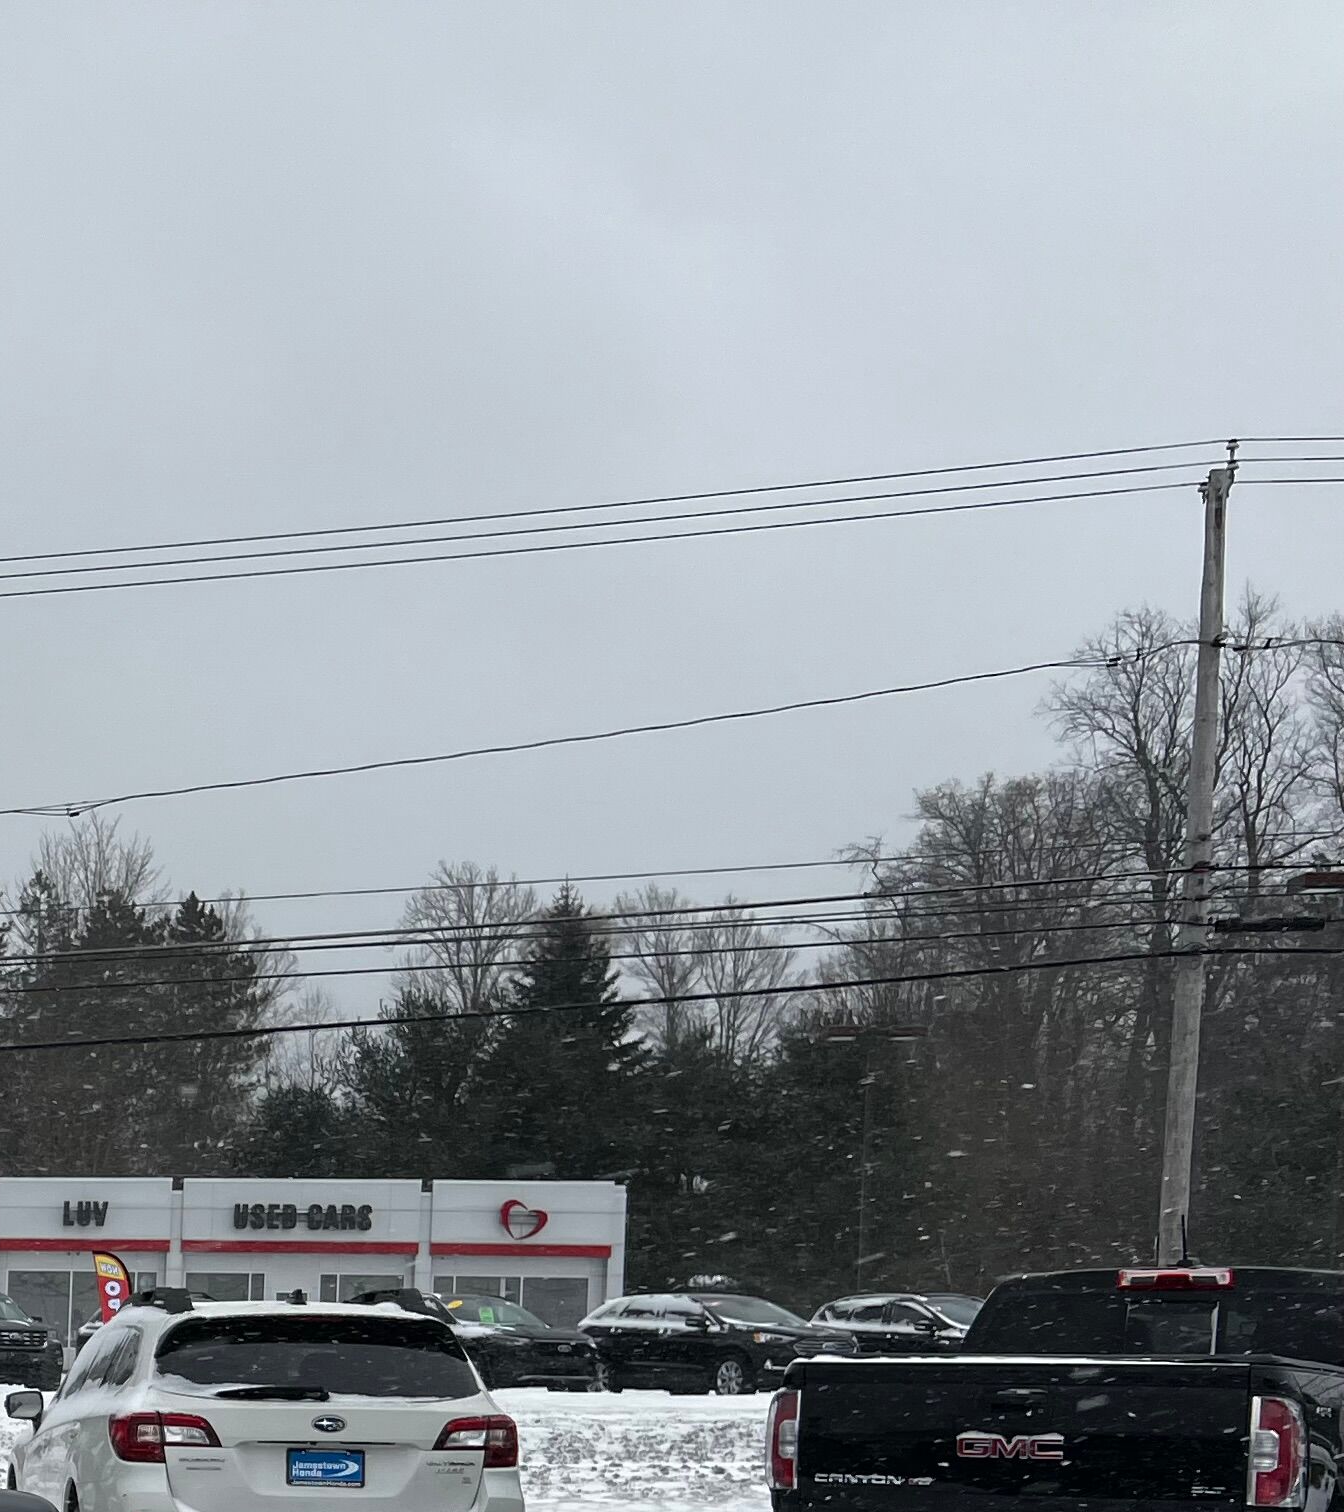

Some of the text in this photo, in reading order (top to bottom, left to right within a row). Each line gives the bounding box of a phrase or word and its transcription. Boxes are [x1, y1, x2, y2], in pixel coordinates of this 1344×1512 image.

[63, 1201, 109, 1227] LUV
[233, 1203, 373, 1231] USED CARS
[956, 1434, 1064, 1460] GMC
[292, 1461, 346, 1470] Jamestown
[292, 1468, 323, 1478] Honda
[814, 1473, 905, 1485] CANYON
